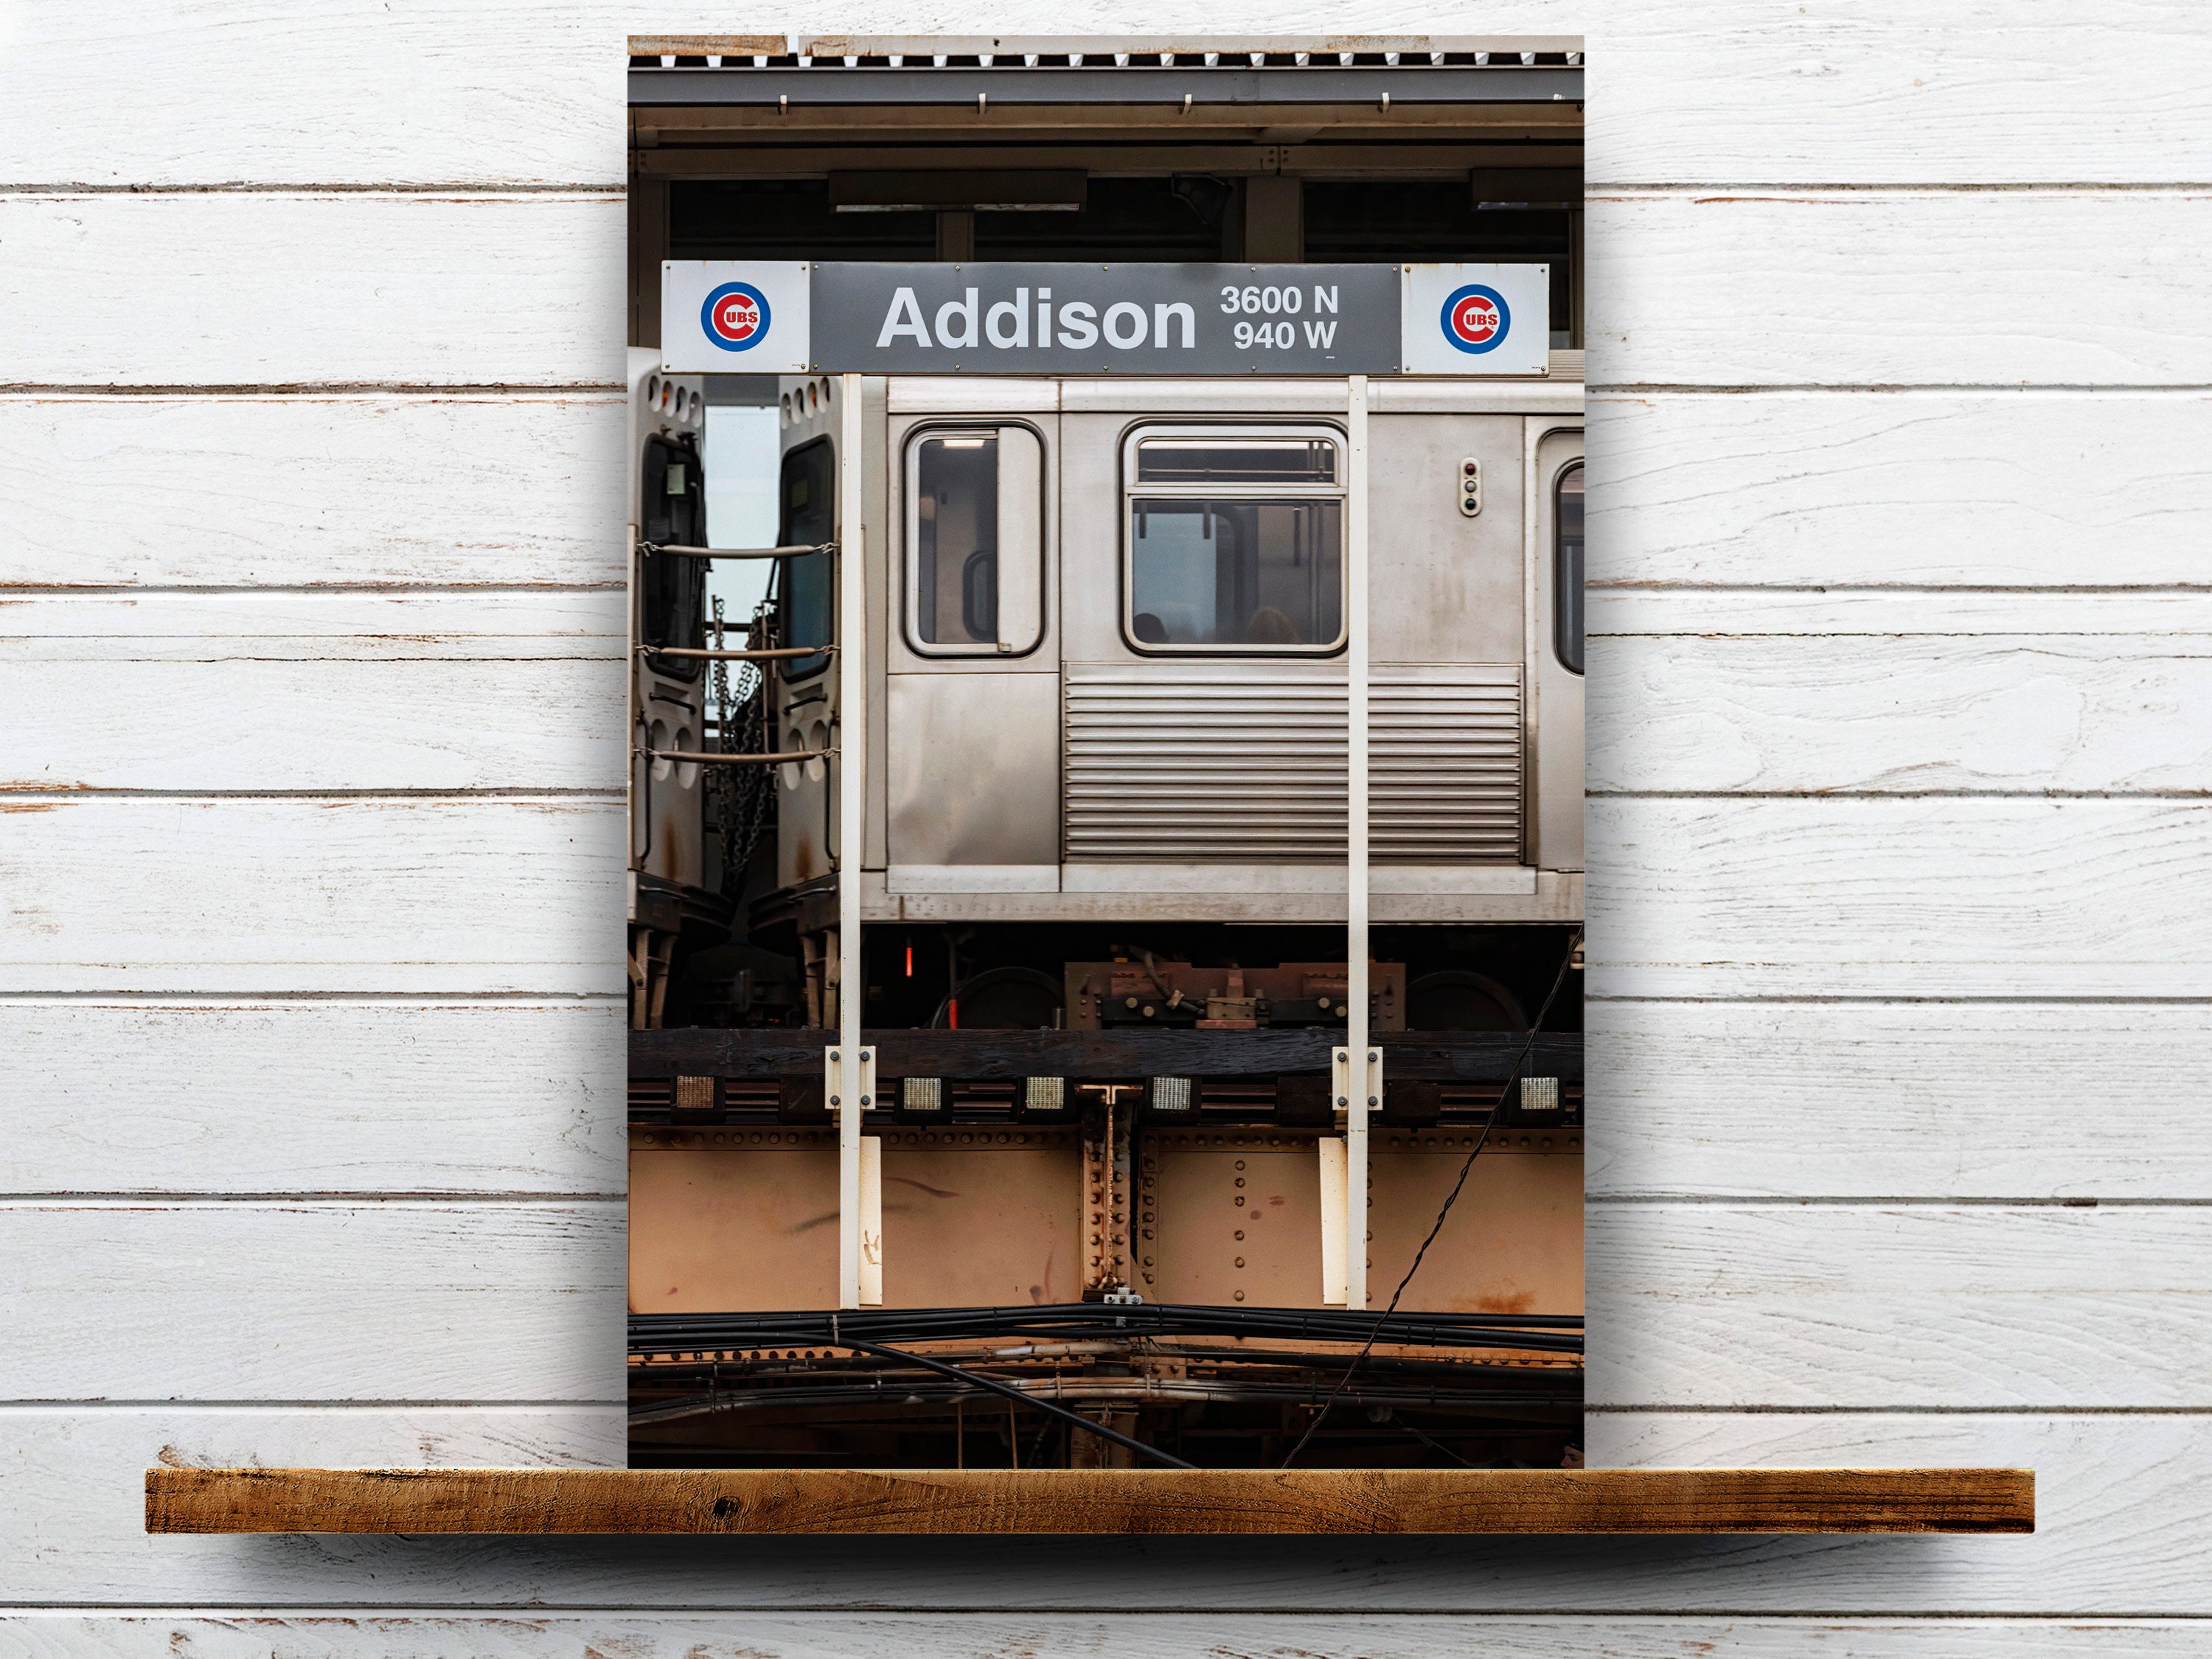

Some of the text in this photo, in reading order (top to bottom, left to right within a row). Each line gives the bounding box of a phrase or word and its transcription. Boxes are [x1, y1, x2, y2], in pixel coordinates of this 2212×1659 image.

[713, 294, 758, 340] CUBS
[875, 287, 1195, 349] Addison
[1220, 285, 1338, 314] 3600 N
[1453, 296, 1498, 342] CUBS
[1234, 321, 1338, 349] 940 W
